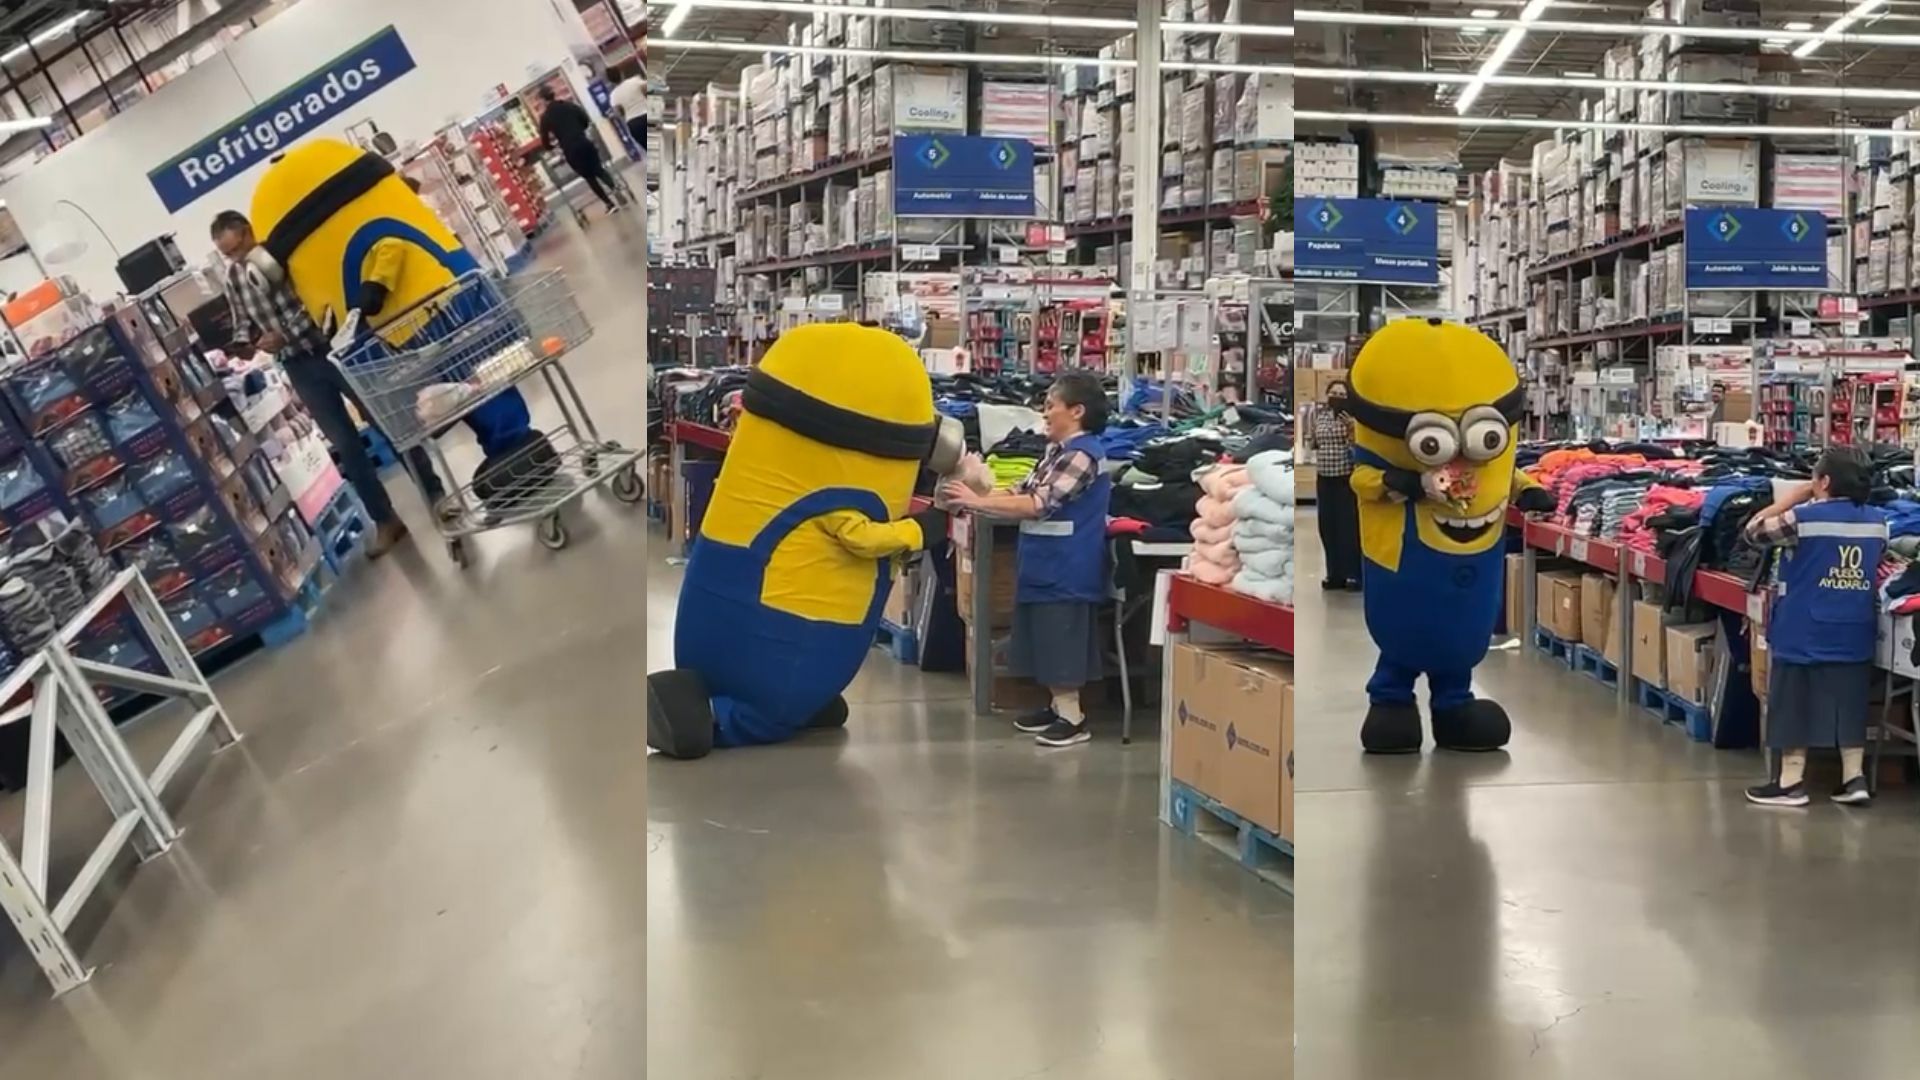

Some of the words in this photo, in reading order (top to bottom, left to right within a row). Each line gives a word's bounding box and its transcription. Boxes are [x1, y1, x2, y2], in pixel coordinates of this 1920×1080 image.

[909, 107, 949, 119] Cooling
[178, 57, 382, 189] Refrigerados
[928, 149, 936, 160] 5
[999, 150, 1006, 161] 6
[1700, 179, 1741, 192] Cooling
[1320, 211, 1329, 222] 3
[1397, 214, 1405, 225] 4
[1720, 221, 1727, 232] 5
[1791, 222, 1799, 233] 6
[1838, 545, 1863, 569] YO
[1828, 566, 1865, 579] PUEDO
[1818, 577, 1871, 591] AYUDARLO
